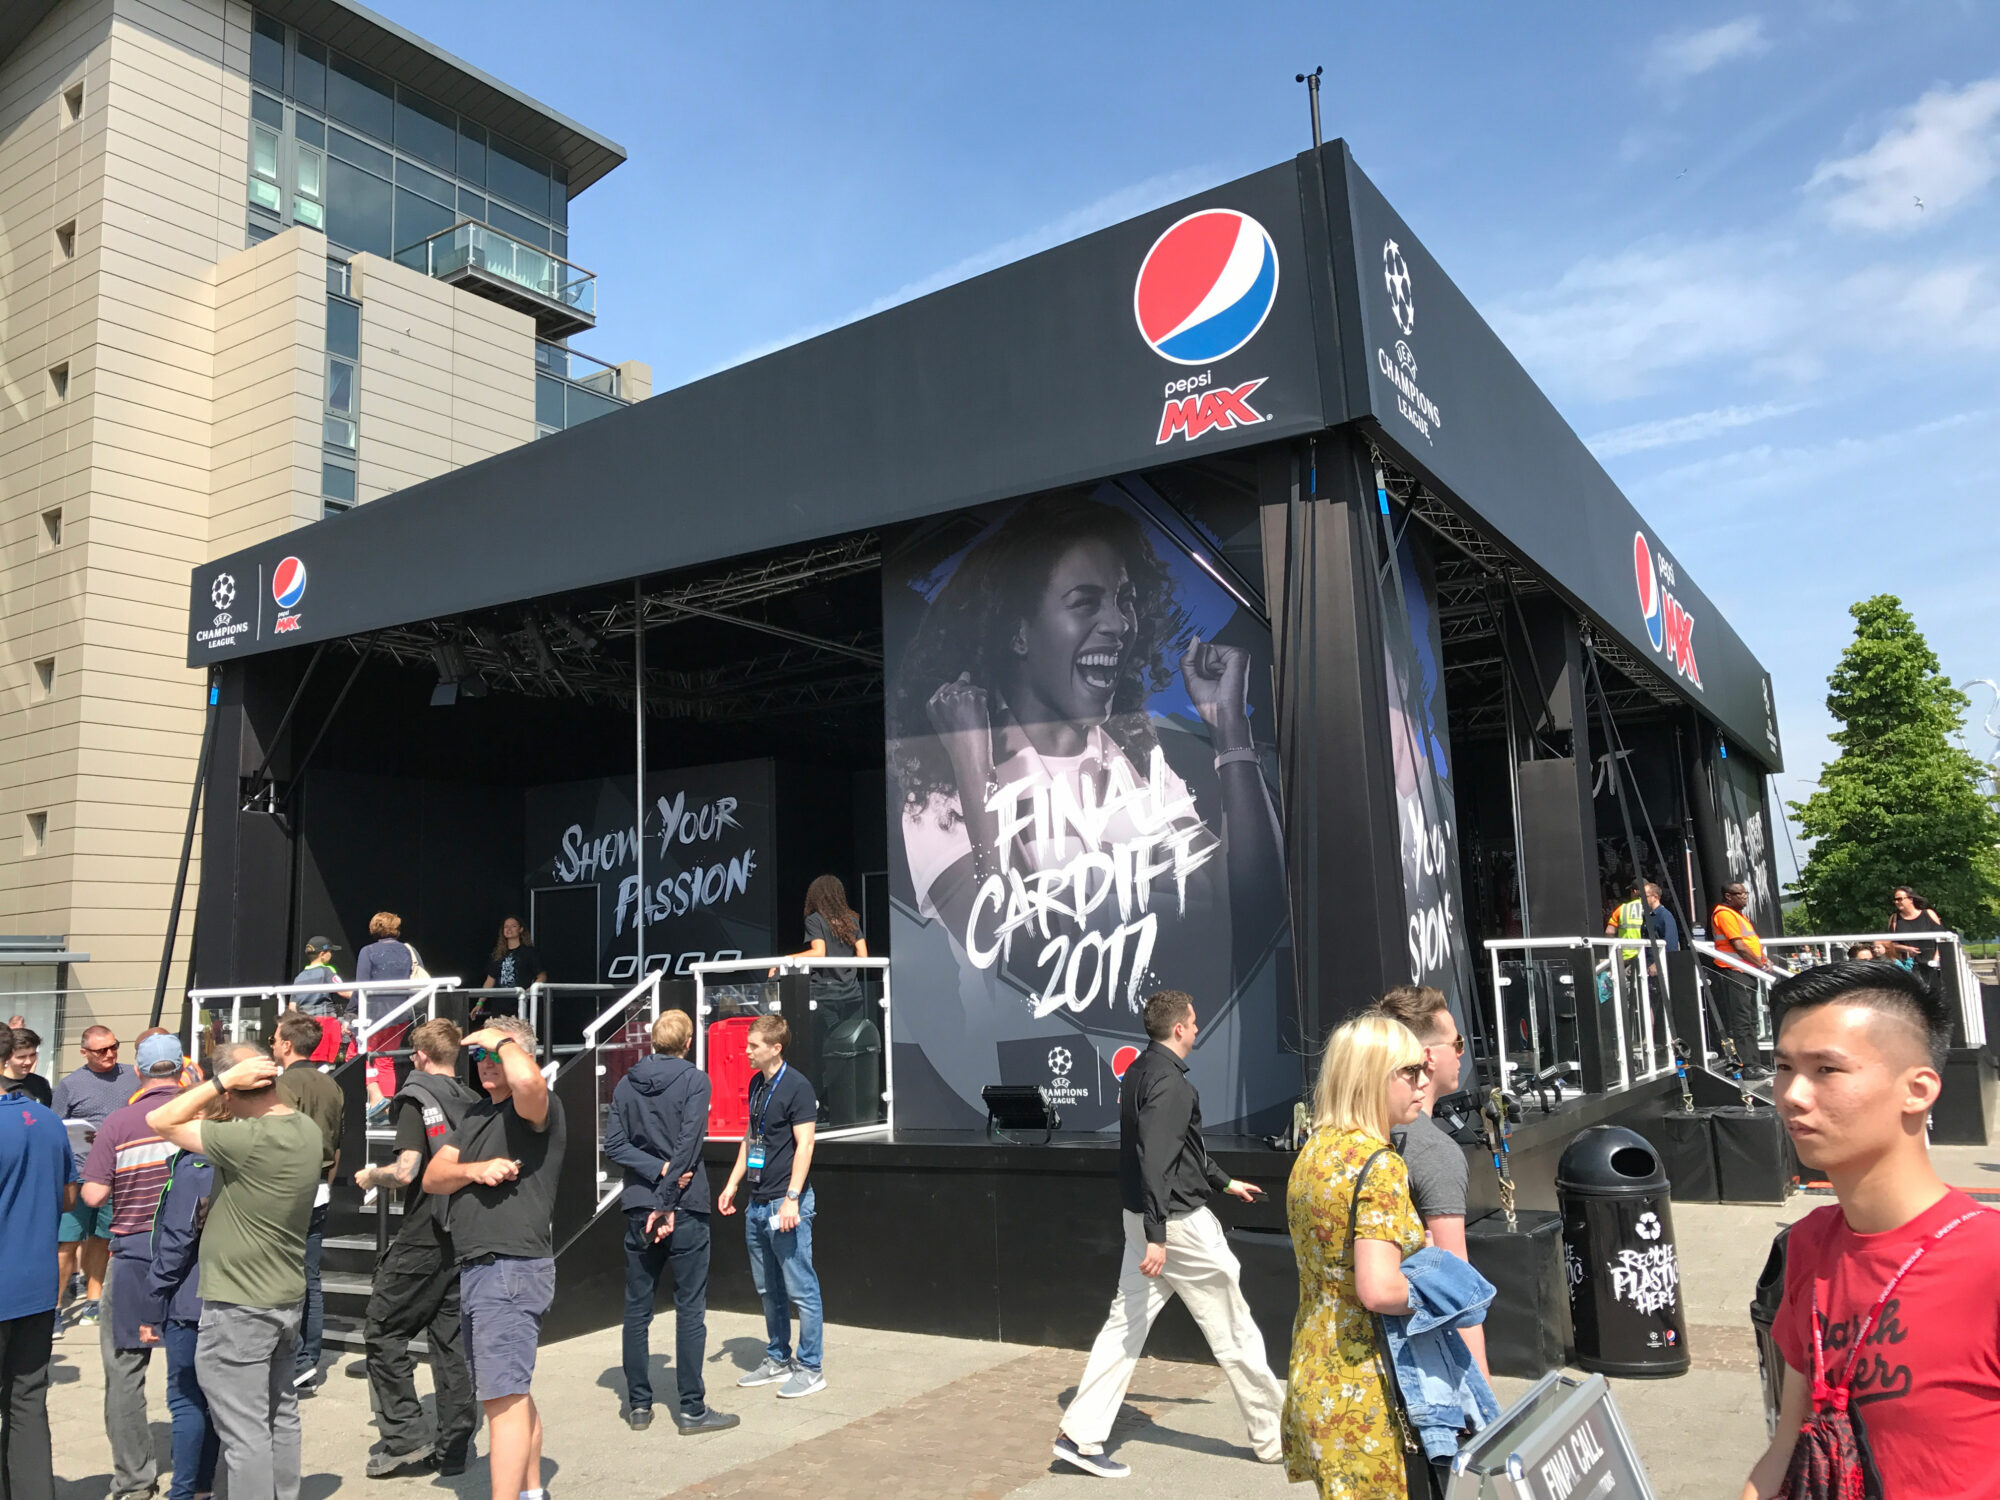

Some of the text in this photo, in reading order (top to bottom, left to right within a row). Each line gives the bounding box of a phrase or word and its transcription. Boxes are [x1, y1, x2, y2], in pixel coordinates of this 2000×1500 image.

[1165, 370, 1212, 398] pepsi
[1378, 348, 1441, 428] CHAMPIONS
[1155, 376, 1270, 445] MAX
[1397, 394, 1430, 439] LEAGUE
[1657, 552, 1676, 587] pepsi
[196, 622, 249, 642] CHAMPIONS
[213, 613, 233, 627] UEFA
[274, 614, 302, 634] MAX
[1661, 584, 1702, 690] MAX
[208, 637, 236, 649] LEAGUE
[656, 790, 745, 861] YOUR
[985, 745, 1198, 876] FINAL
[614, 848, 757, 938] PASSION
[965, 820, 1222, 970] CARDIFF
[1030, 912, 1160, 1020] 2017
[1051, 1077, 1071, 1089] UEFA
[1617, 1244, 1677, 1272] RECYCLE
[1610, 1261, 1679, 1302] PLASTIC
[1635, 1288, 1676, 1317] HERE
[1541, 1445, 1581, 1500] FINAL
[1570, 1420, 1604, 1475] CALL
